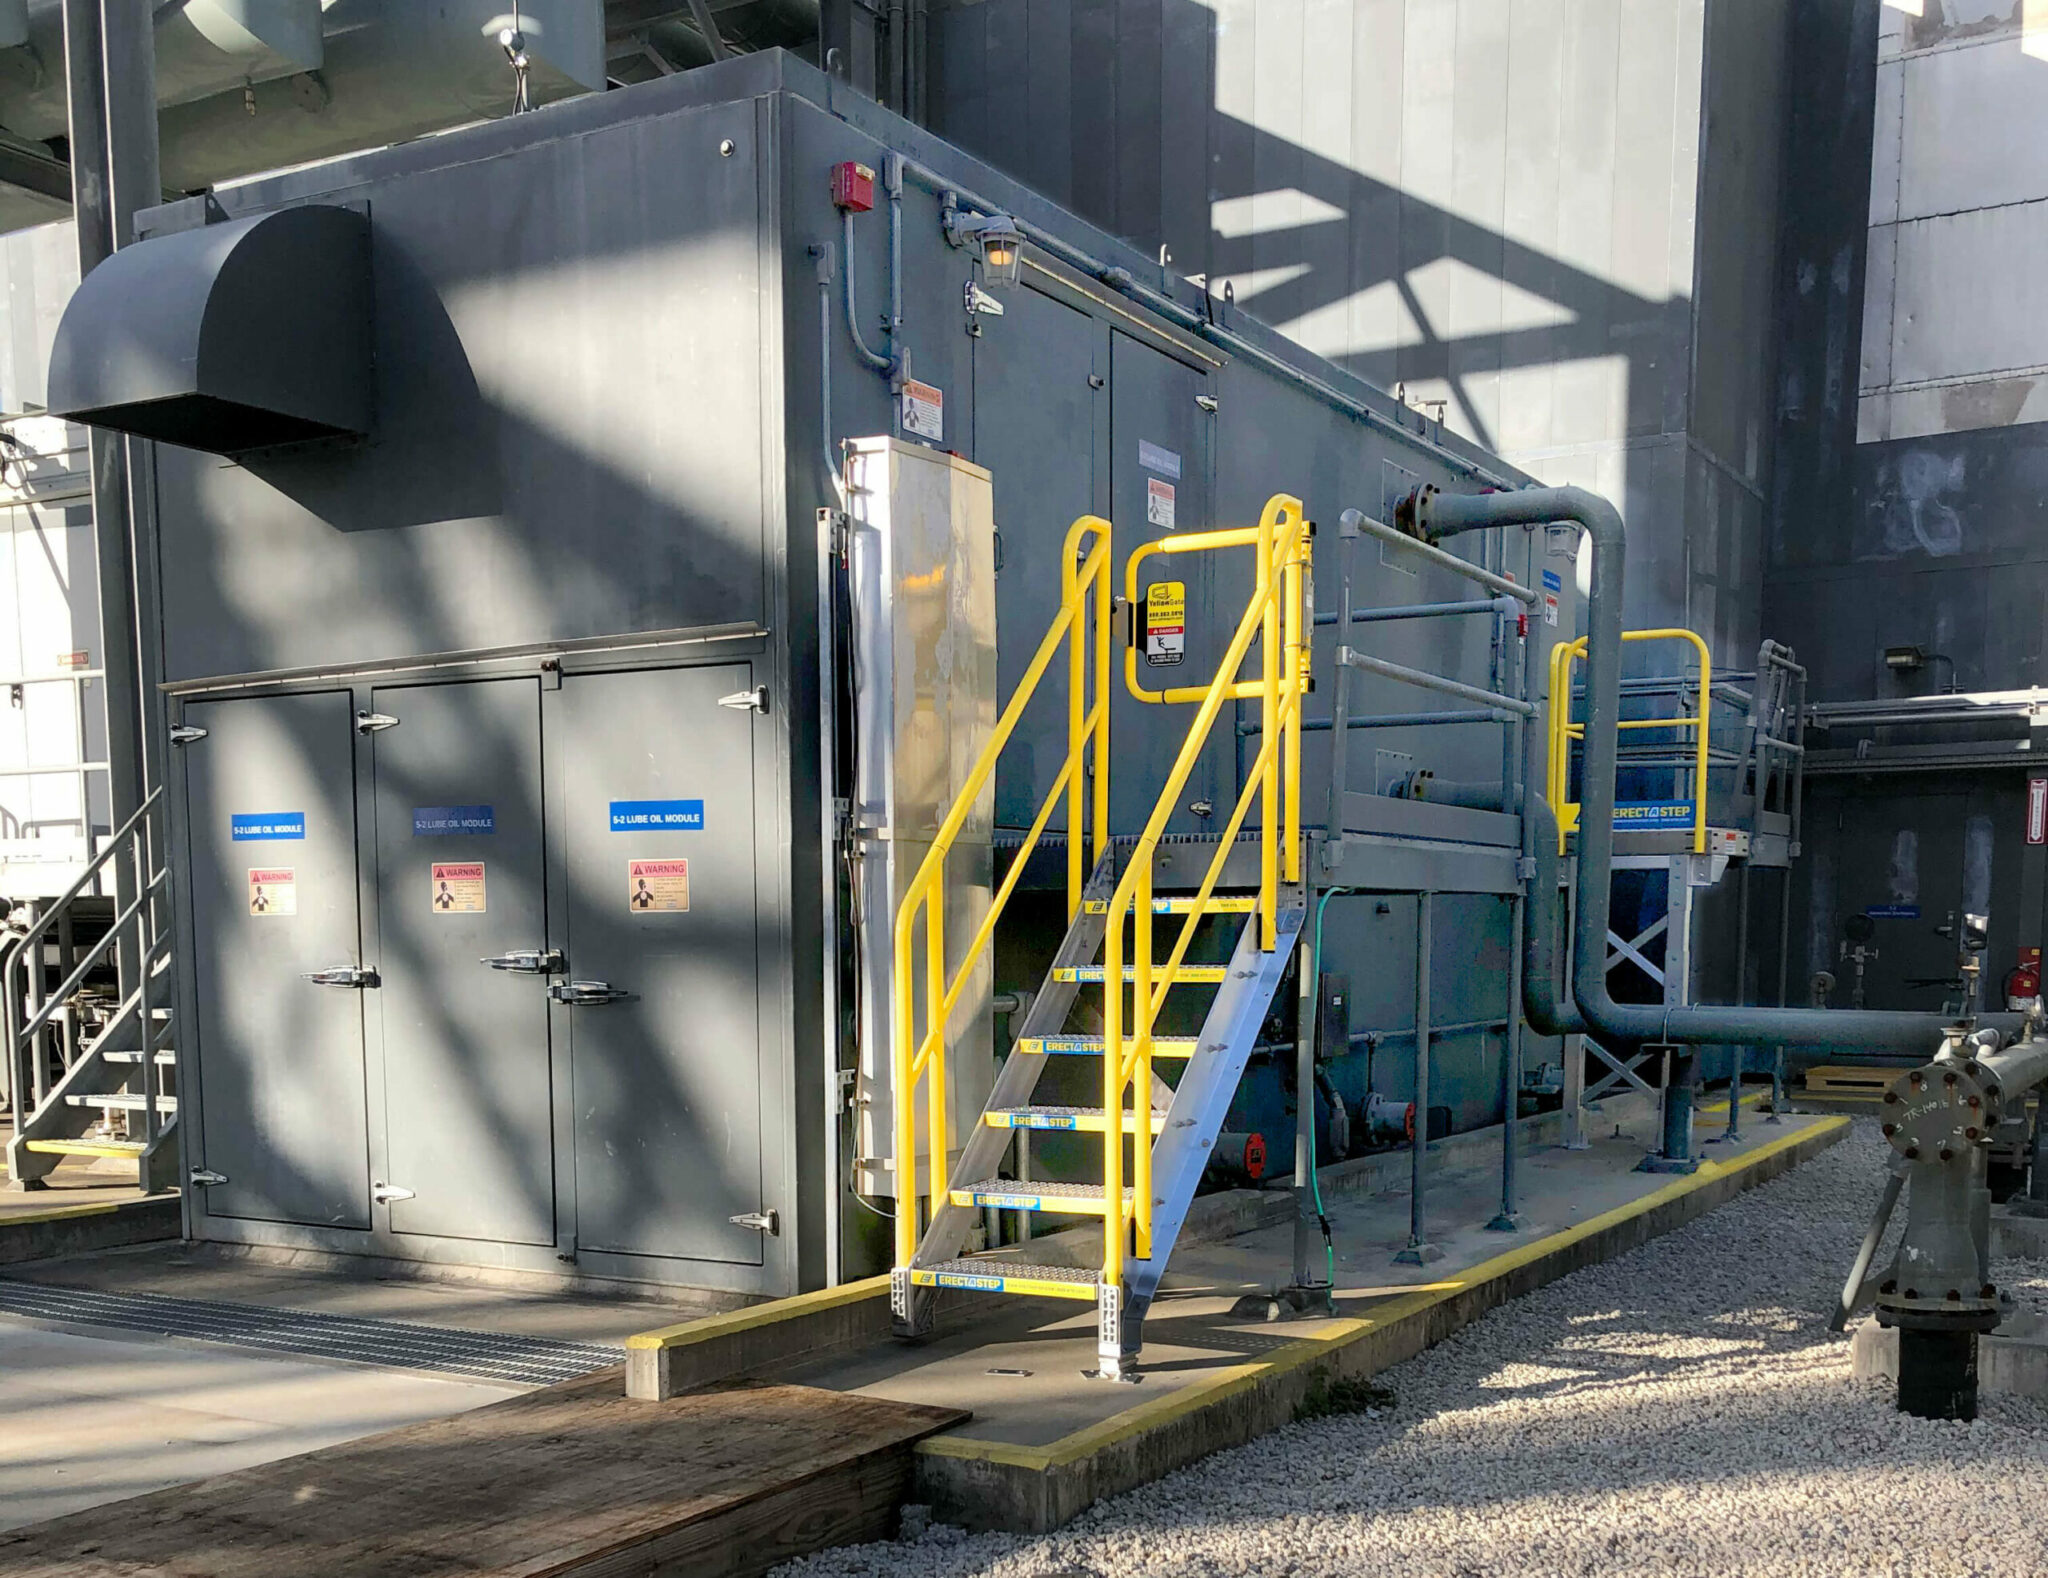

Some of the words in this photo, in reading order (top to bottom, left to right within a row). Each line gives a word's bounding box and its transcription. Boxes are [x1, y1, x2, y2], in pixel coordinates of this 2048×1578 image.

[613, 815, 625, 824] 5-2
[627, 815, 648, 824] LUBE
[650, 814, 663, 823] OIL
[665, 813, 700, 823] MODULE
[416, 820, 426, 828] 5-2
[427, 820, 446, 828] LUBE
[448, 819, 460, 828] OIL
[462, 819, 492, 827] MODULE
[244, 825, 262, 834] LUBE
[263, 825, 273, 834] OIL
[274, 824, 302, 833] MODULE
[446, 868, 482, 876] WARNING
[645, 864, 685, 873] WARNING
[261, 872, 293, 881] WARNING
[938, 1275, 1001, 1289] ERECTASTEP
